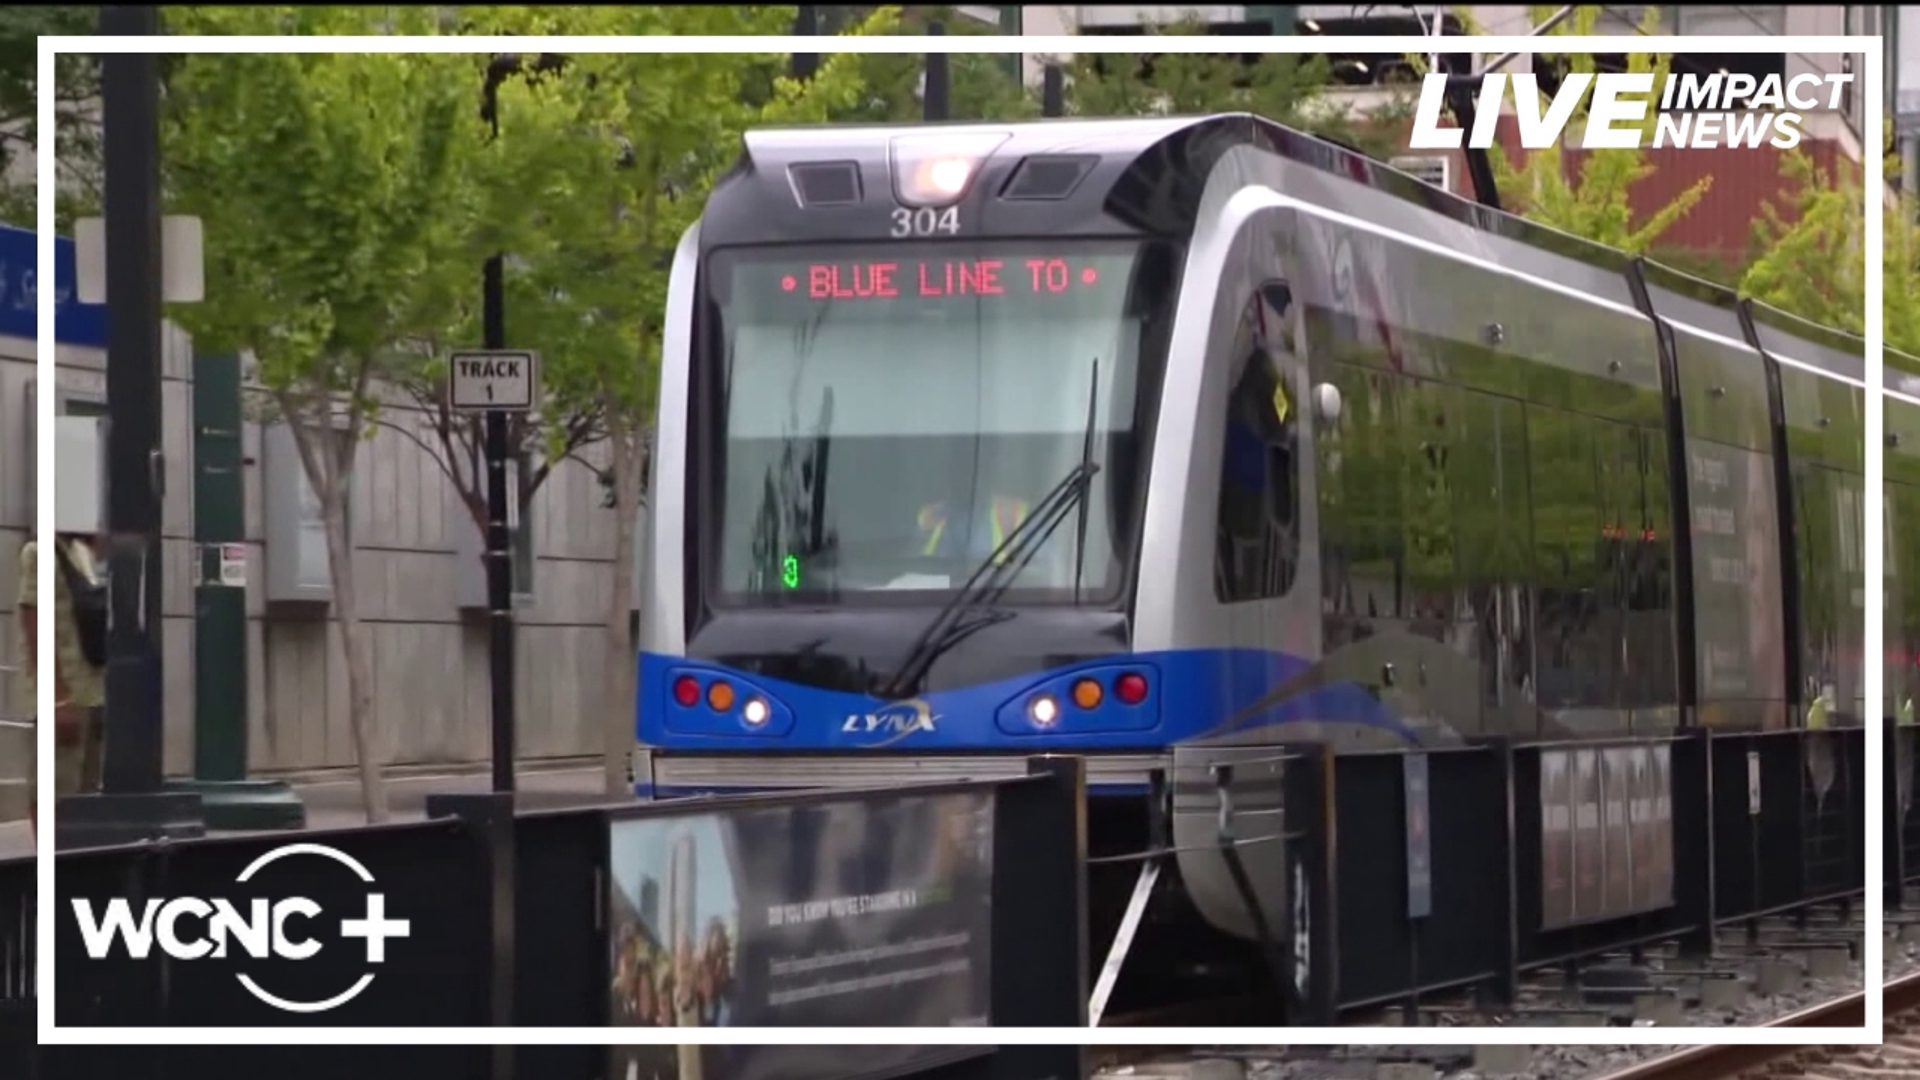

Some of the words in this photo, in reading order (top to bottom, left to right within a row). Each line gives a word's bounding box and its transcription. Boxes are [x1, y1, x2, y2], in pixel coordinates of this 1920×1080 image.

[890, 205, 961, 238] 304
[809, 263, 898, 298] BLUE
[919, 260, 1005, 295] LINE
[1026, 258, 1069, 292] TO
[460, 360, 520, 379] TRACK
[485, 383, 494, 402] 1
[841, 713, 944, 732] LYNX
